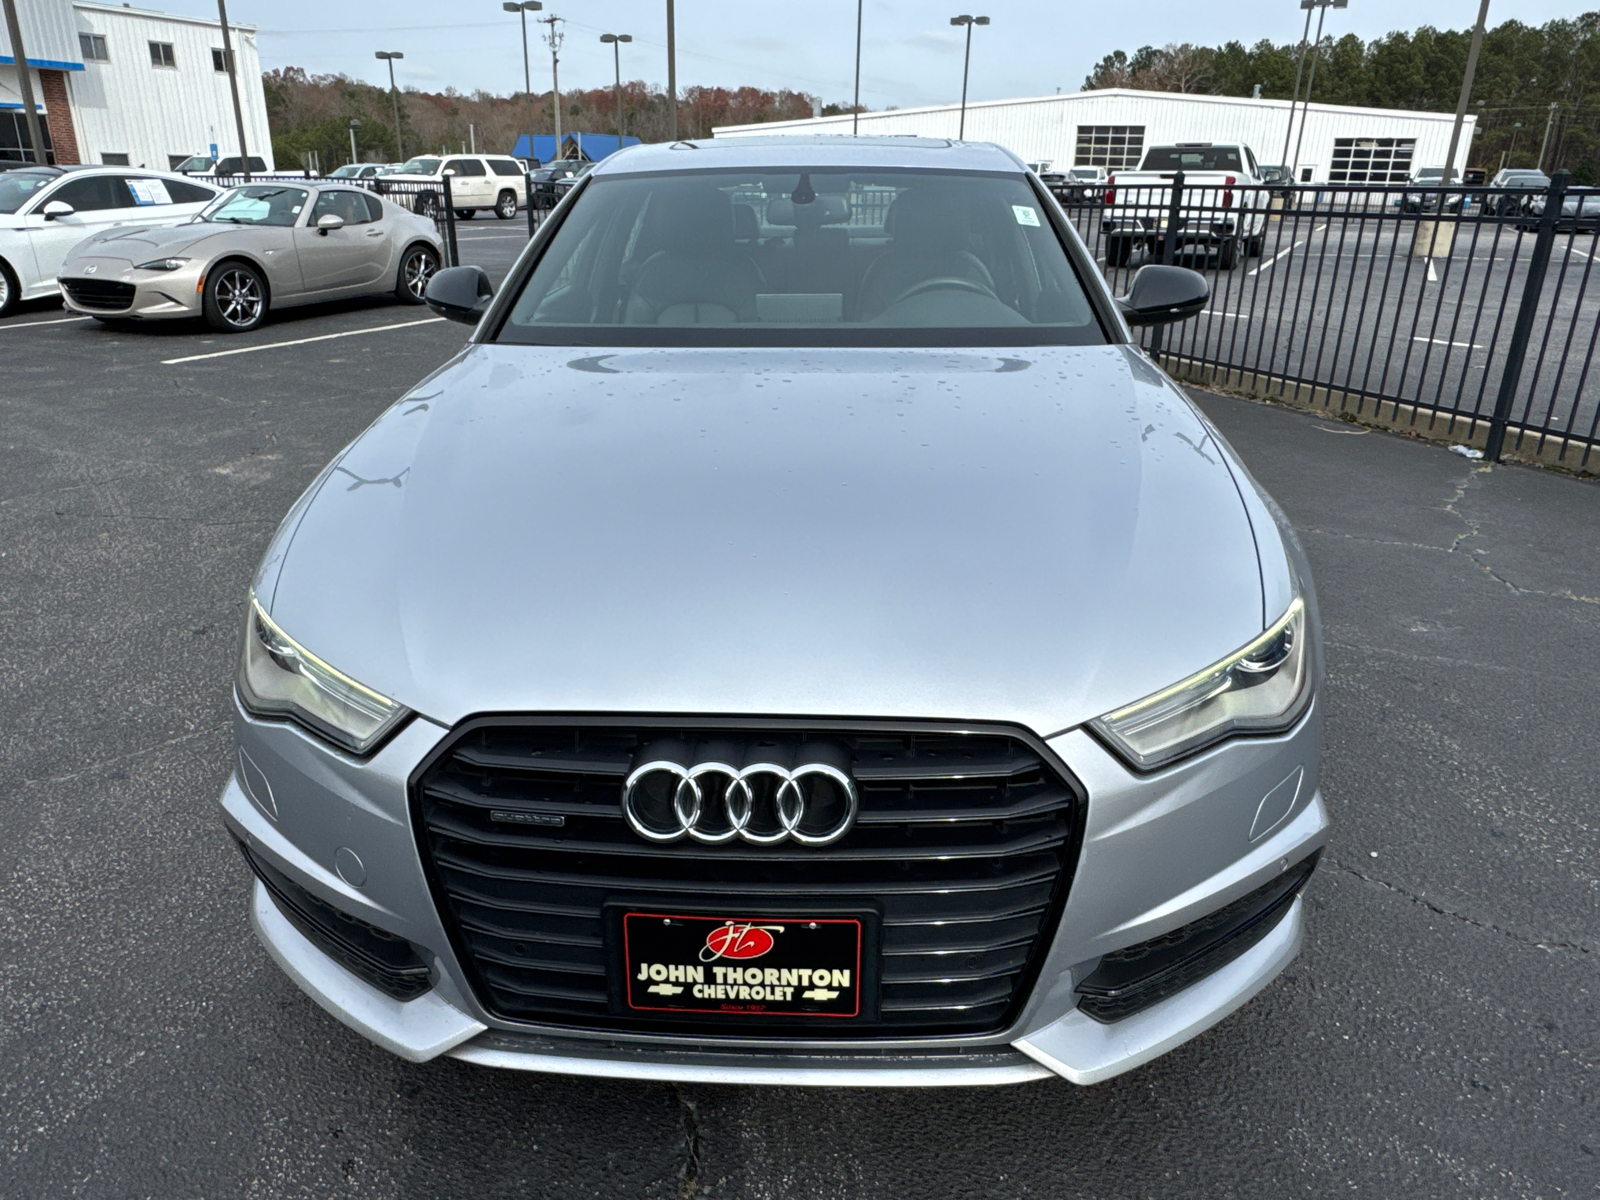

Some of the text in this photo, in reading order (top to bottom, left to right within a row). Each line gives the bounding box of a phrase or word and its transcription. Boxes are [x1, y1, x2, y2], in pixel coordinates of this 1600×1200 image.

[637, 963, 850, 987] JOHN THORNTON
[692, 984, 794, 1001] CHEVROLET
